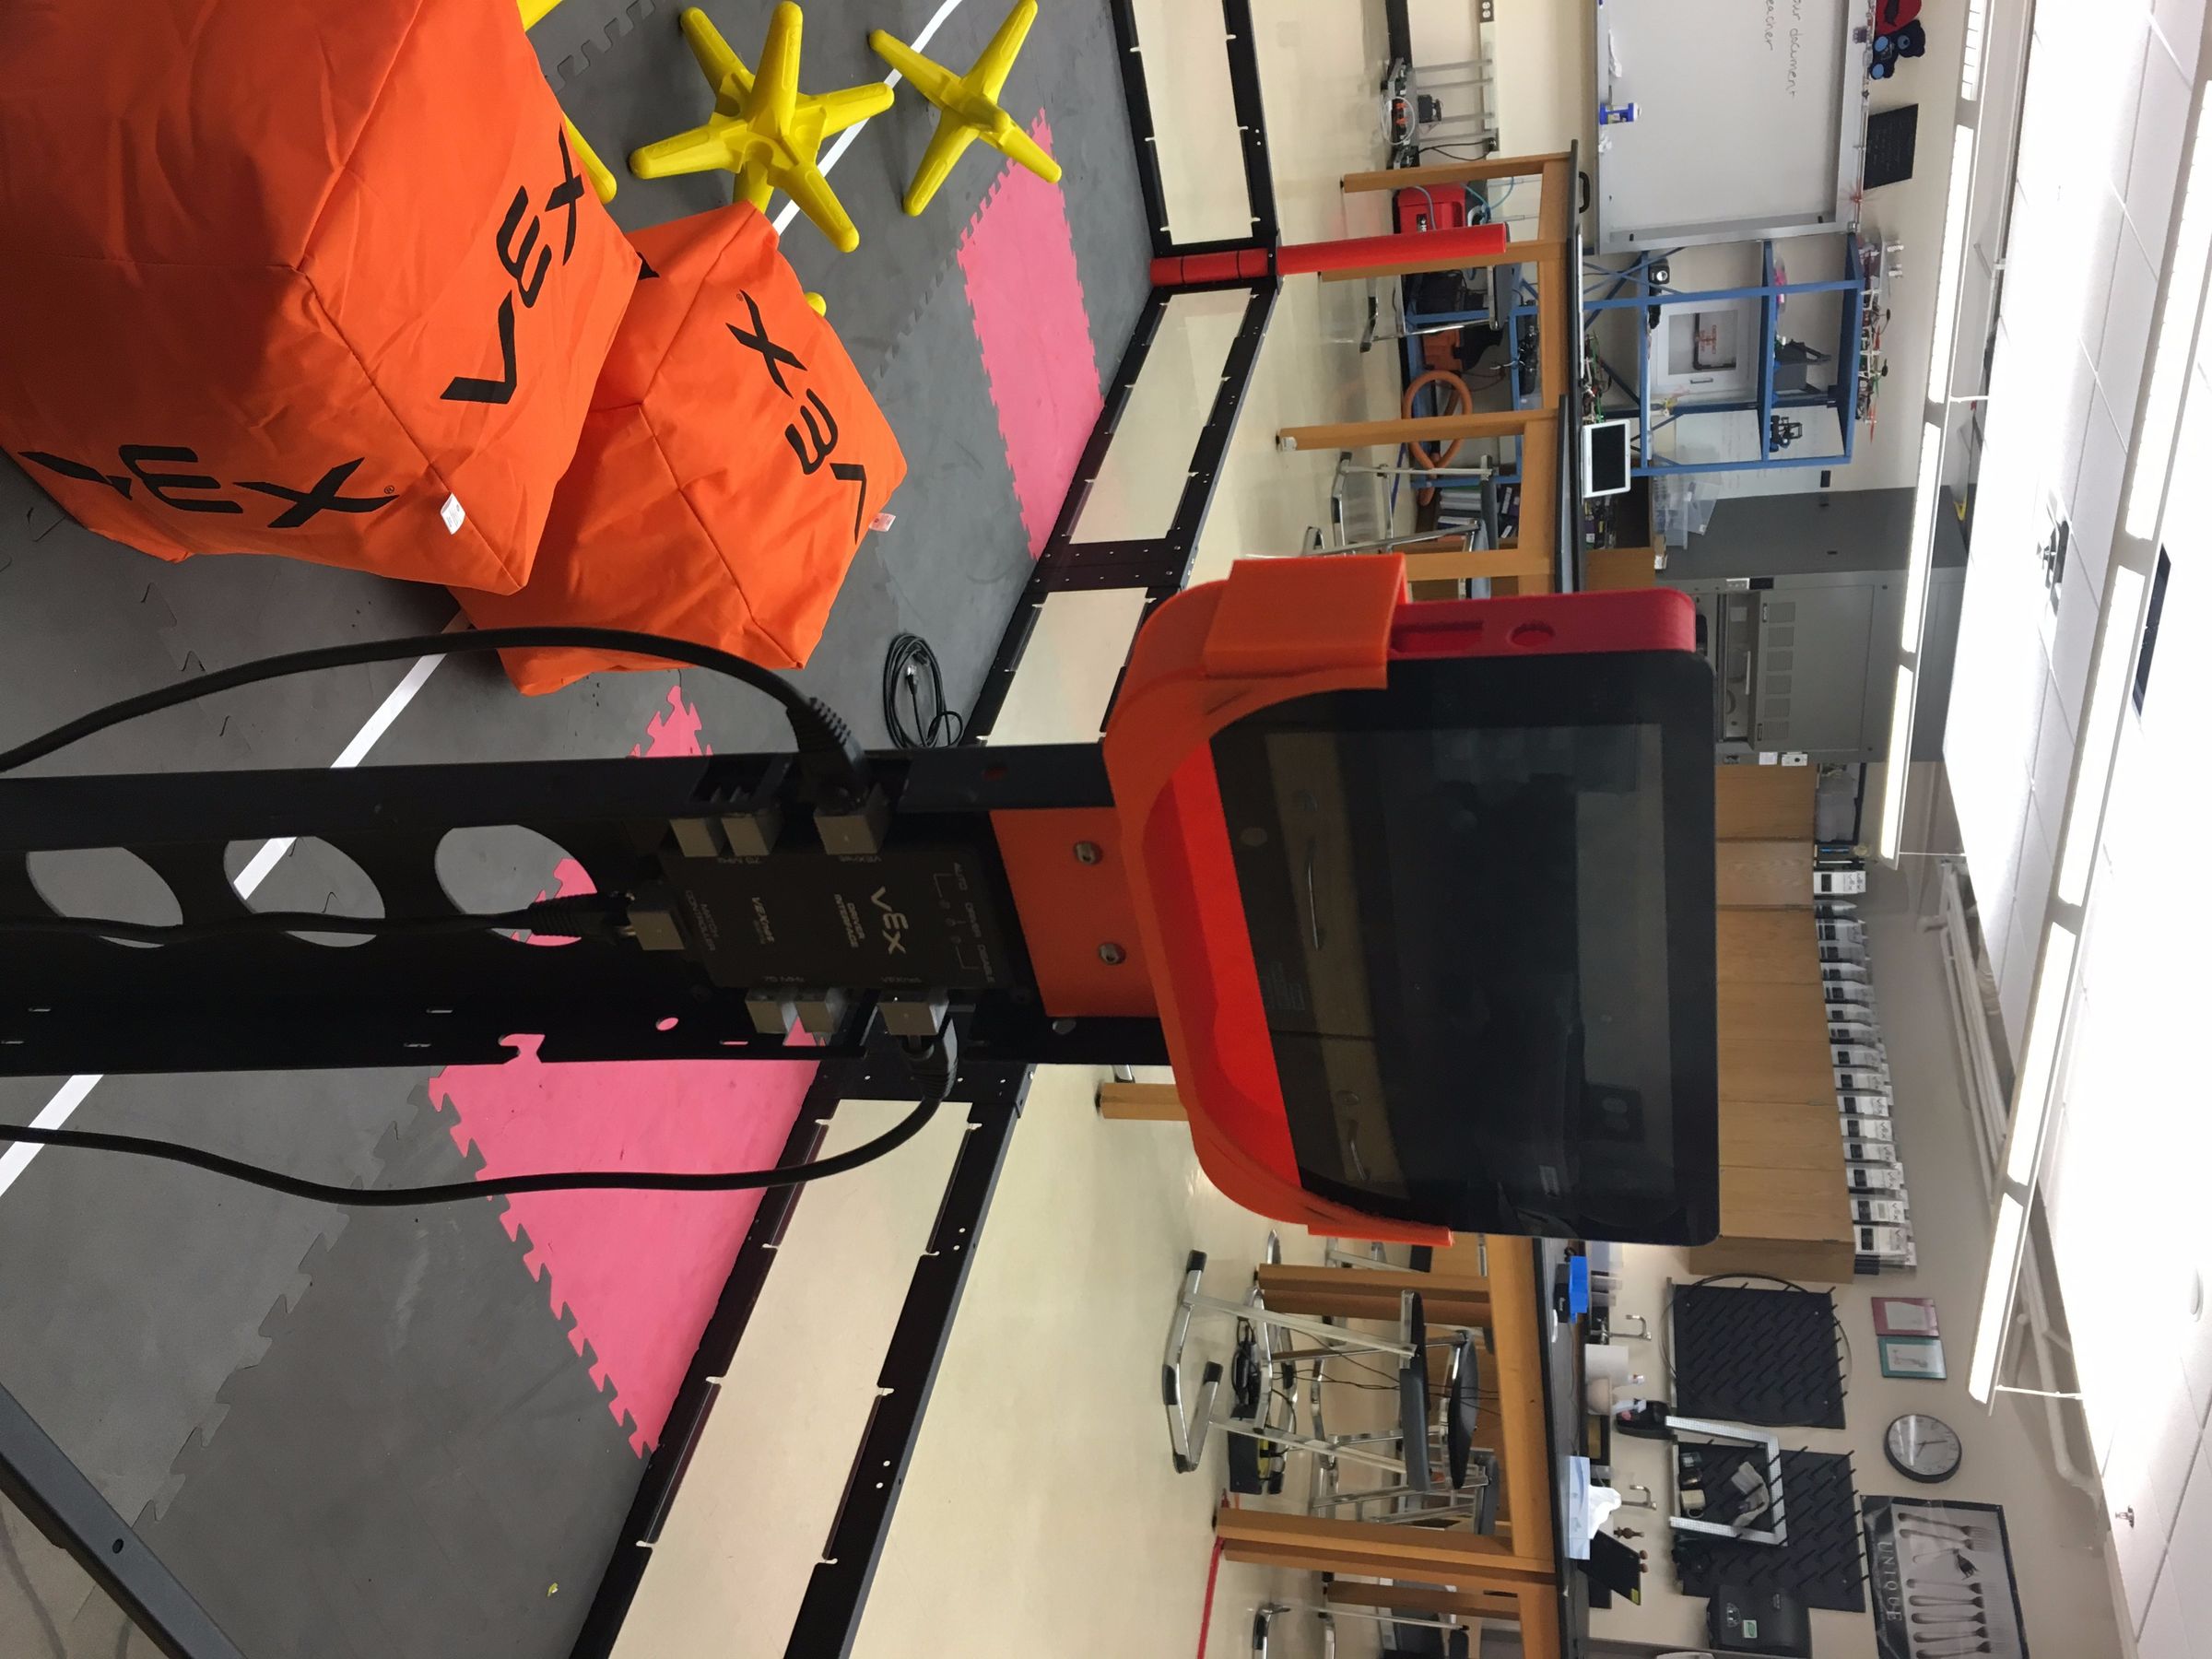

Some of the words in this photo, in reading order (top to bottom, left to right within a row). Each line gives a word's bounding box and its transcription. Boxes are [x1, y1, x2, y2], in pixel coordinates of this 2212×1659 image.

[1786, 29, 1804, 98] document
[440, 123, 585, 405] VEX
[724, 288, 866, 546] VEX
[953, 862, 969, 891] AUTO
[685, 889, 717, 951] CONTROLLER
[700, 903, 721, 938] MATCH
[833, 893, 860, 948] INTERFACE
[846, 903, 866, 940] DRIVER
[869, 885, 910, 956] VEX
[964, 901, 982, 938] DRIVER
[977, 944, 996, 983] DISABLE
[1877, 1541, 1902, 1623] UNIQUE
